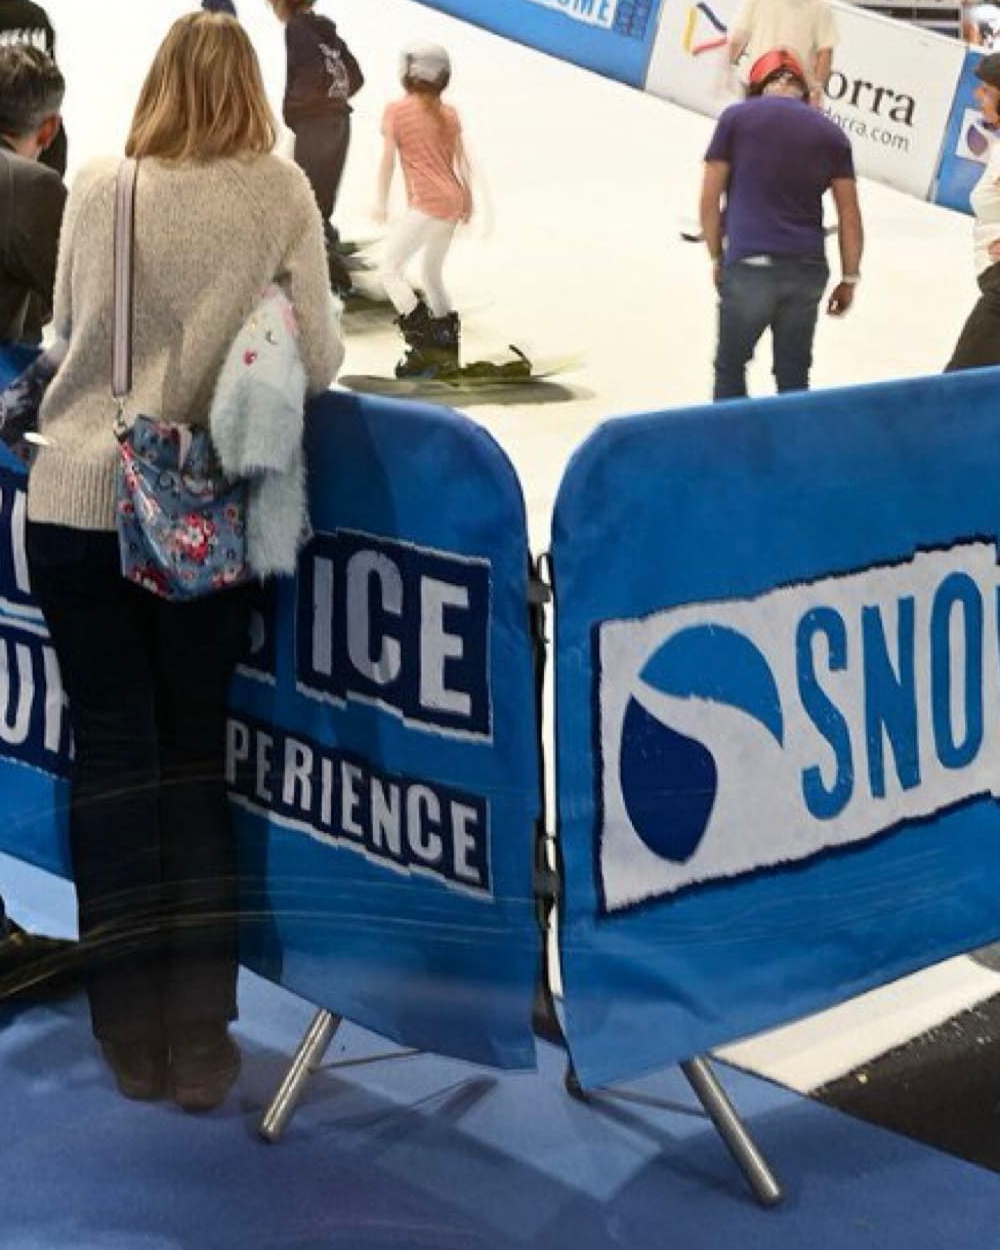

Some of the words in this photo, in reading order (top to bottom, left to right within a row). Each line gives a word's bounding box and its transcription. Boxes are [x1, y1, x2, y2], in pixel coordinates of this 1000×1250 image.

[823, 69, 917, 127] orra
[312, 549, 472, 717] ICE
[795, 571, 1000, 821] SNO
[225, 718, 481, 884] PERIENCE
